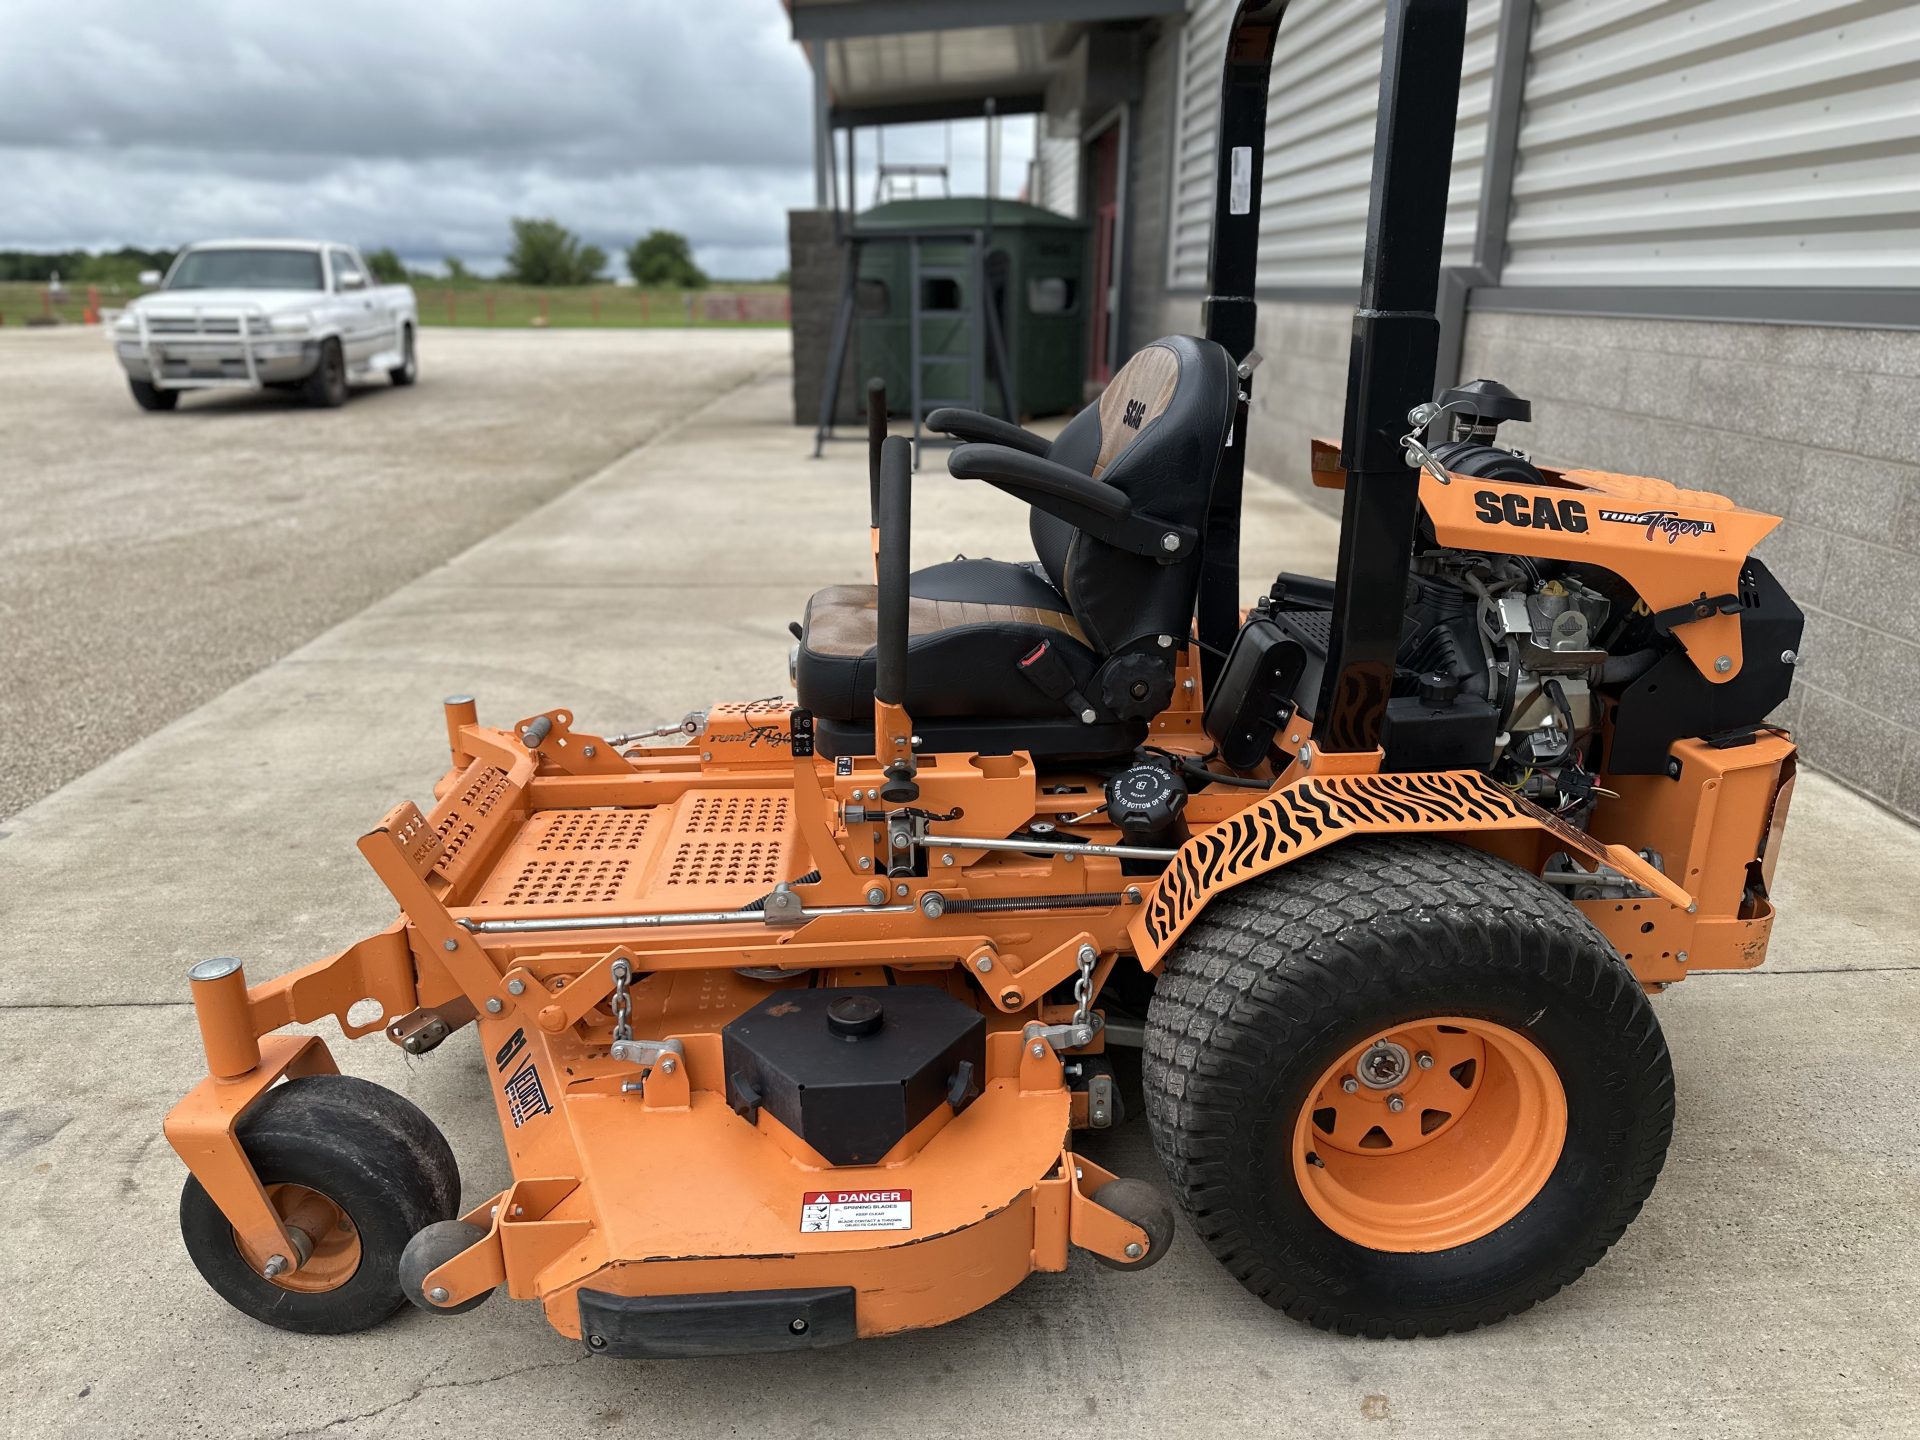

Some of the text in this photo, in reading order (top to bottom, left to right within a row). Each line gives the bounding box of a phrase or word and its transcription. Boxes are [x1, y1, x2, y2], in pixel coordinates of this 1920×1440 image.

[1123, 398, 1146, 430] SCAG
[1474, 490, 1588, 533] SCAG
[1600, 510, 1712, 544] TURF Tiger II
[1120, 797, 1128, 805] TO
[1127, 801, 1151, 809] BOTTOM
[1151, 798, 1160, 806] OF
[1158, 789, 1171, 800] TUBE
[838, 1192, 901, 1202] DANGER
